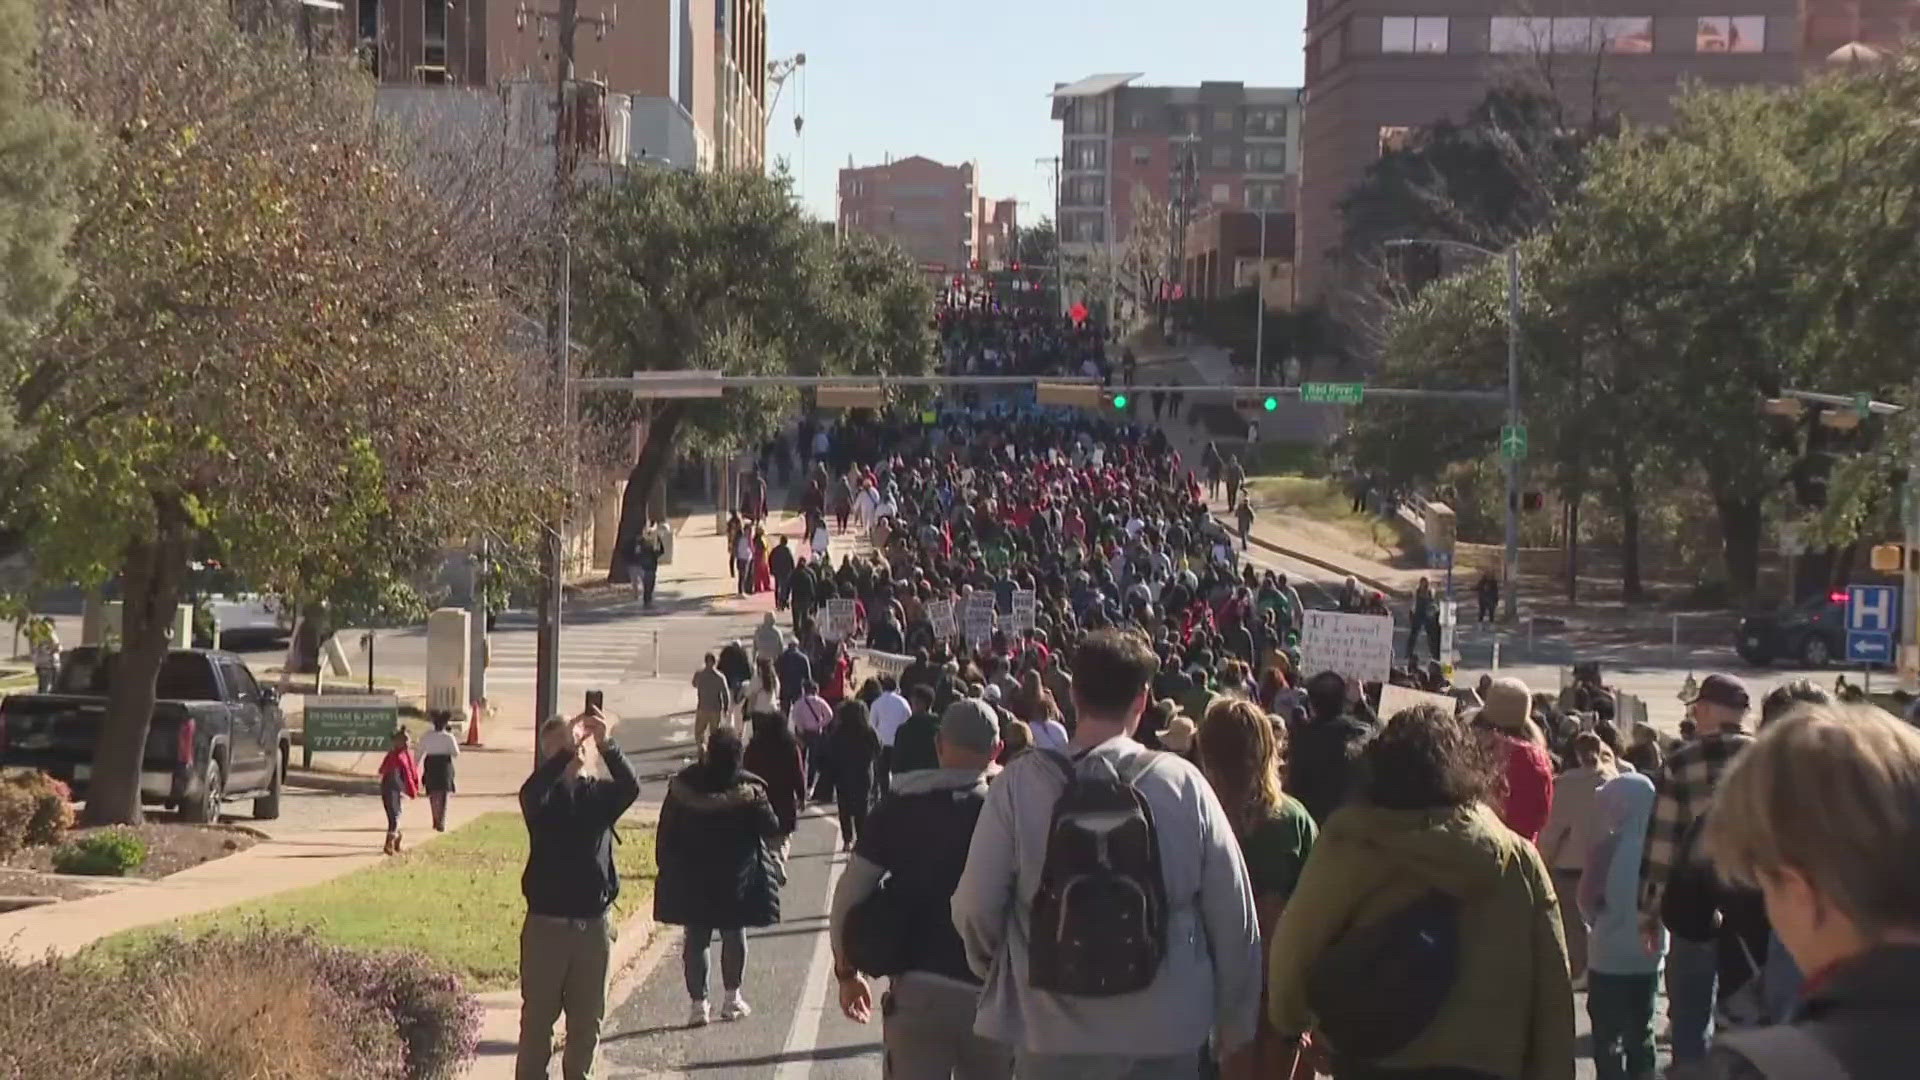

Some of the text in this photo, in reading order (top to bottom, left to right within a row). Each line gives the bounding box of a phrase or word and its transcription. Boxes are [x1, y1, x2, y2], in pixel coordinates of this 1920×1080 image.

[1308, 383, 1353, 395] Red River
[1853, 589, 1888, 629] H
